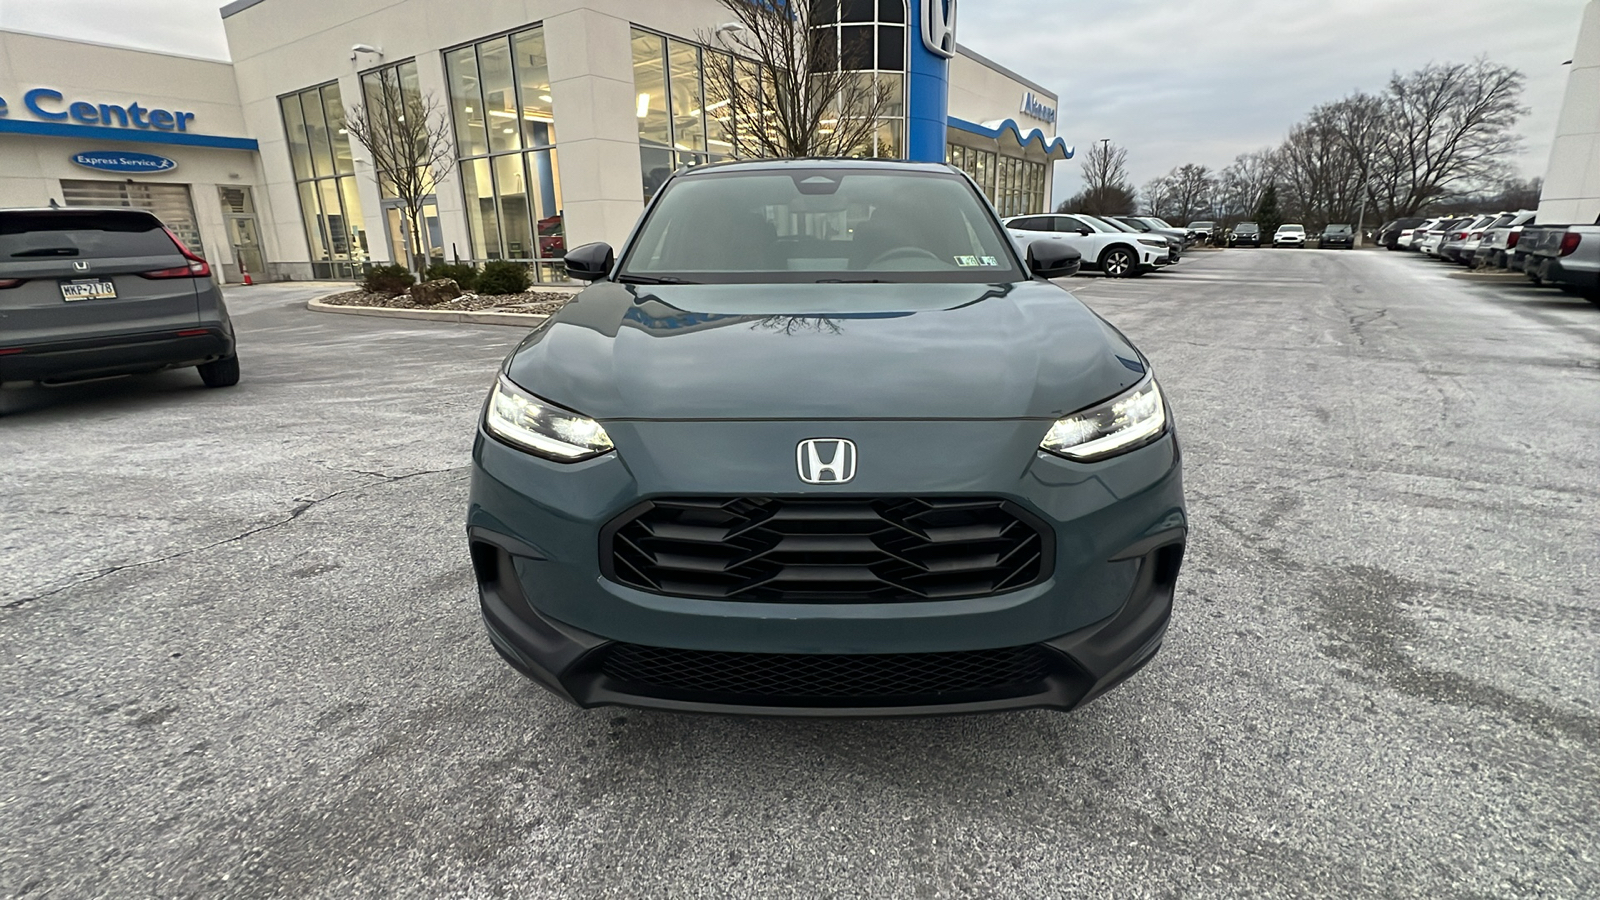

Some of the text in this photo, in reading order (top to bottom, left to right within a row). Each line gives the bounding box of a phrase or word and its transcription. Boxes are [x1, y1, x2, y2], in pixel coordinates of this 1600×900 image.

[24, 88, 195, 132] Center
[77, 155, 156, 167] Express Service
